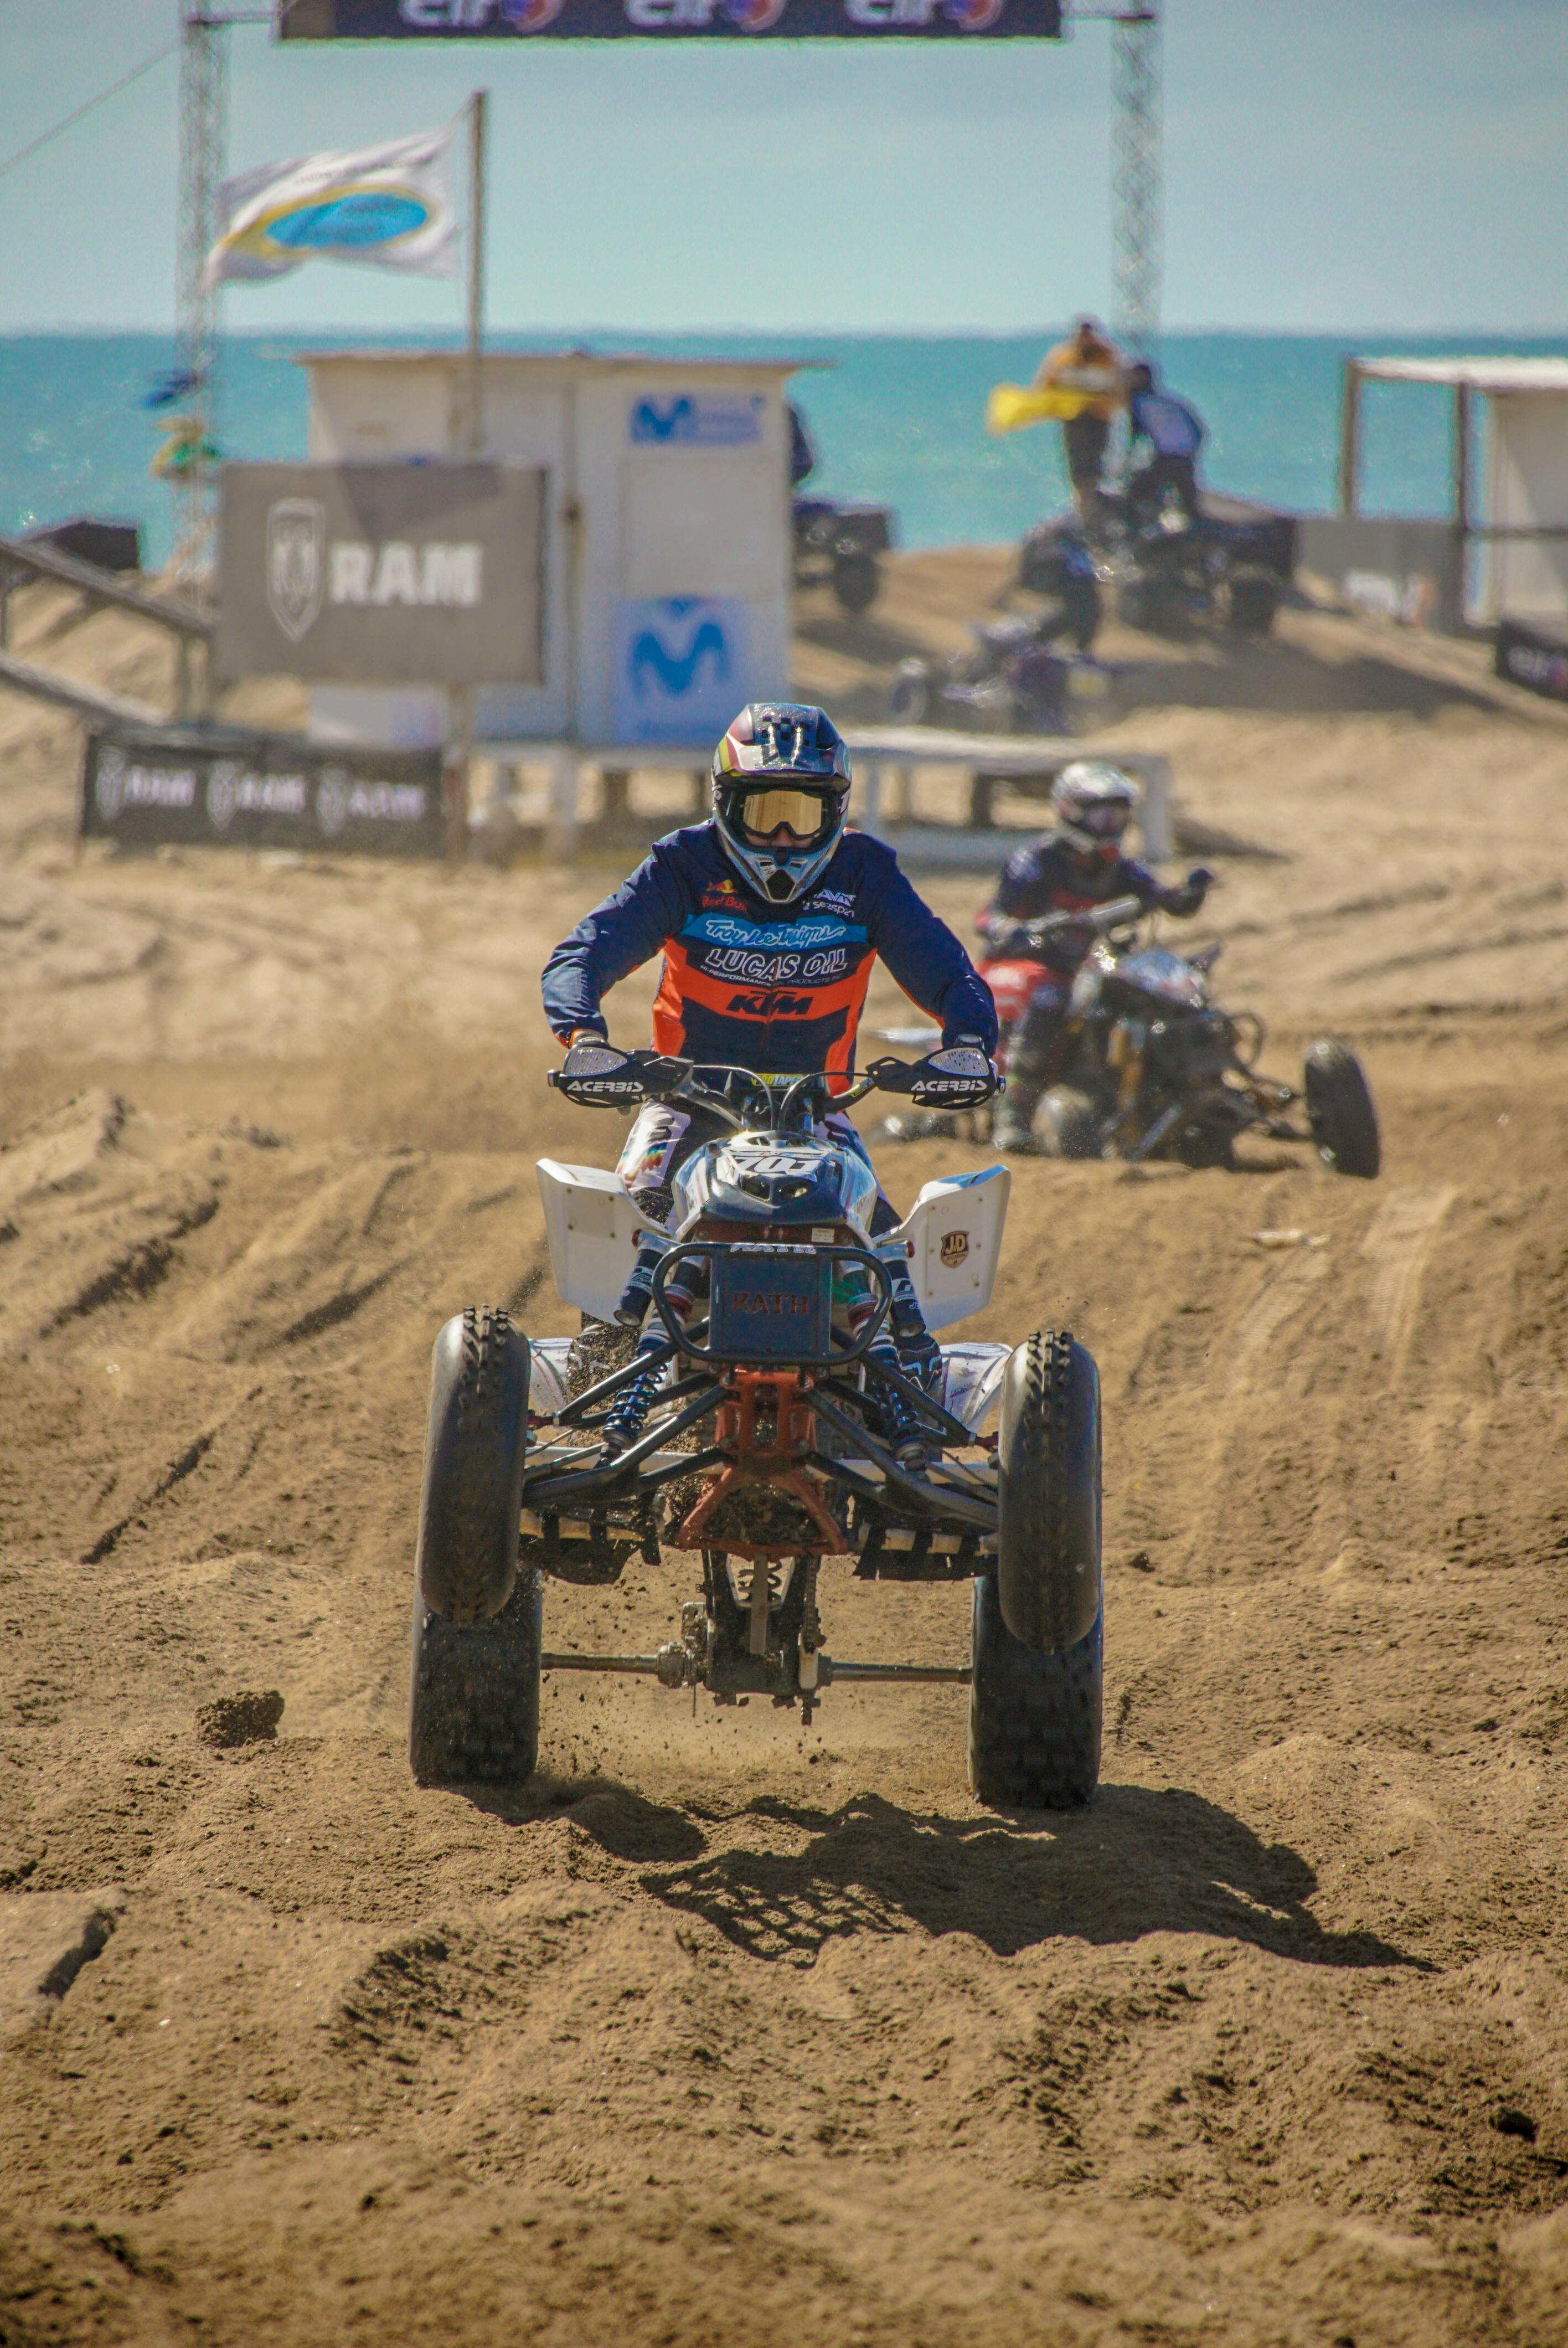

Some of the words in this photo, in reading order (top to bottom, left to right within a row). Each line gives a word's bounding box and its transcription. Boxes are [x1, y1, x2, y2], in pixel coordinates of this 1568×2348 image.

[331, 542, 482, 606] RAM
[702, 894, 725, 908] Red
[706, 919, 749, 946] Troy
[705, 948, 801, 981] LUCAS
[803, 948, 848, 977] OIL
[726, 990, 814, 1017] KTM
[566, 1080, 644, 1093] ACERBIS
[910, 1080, 987, 1092] ACERBIS
[732, 1292, 809, 1315] RATH
